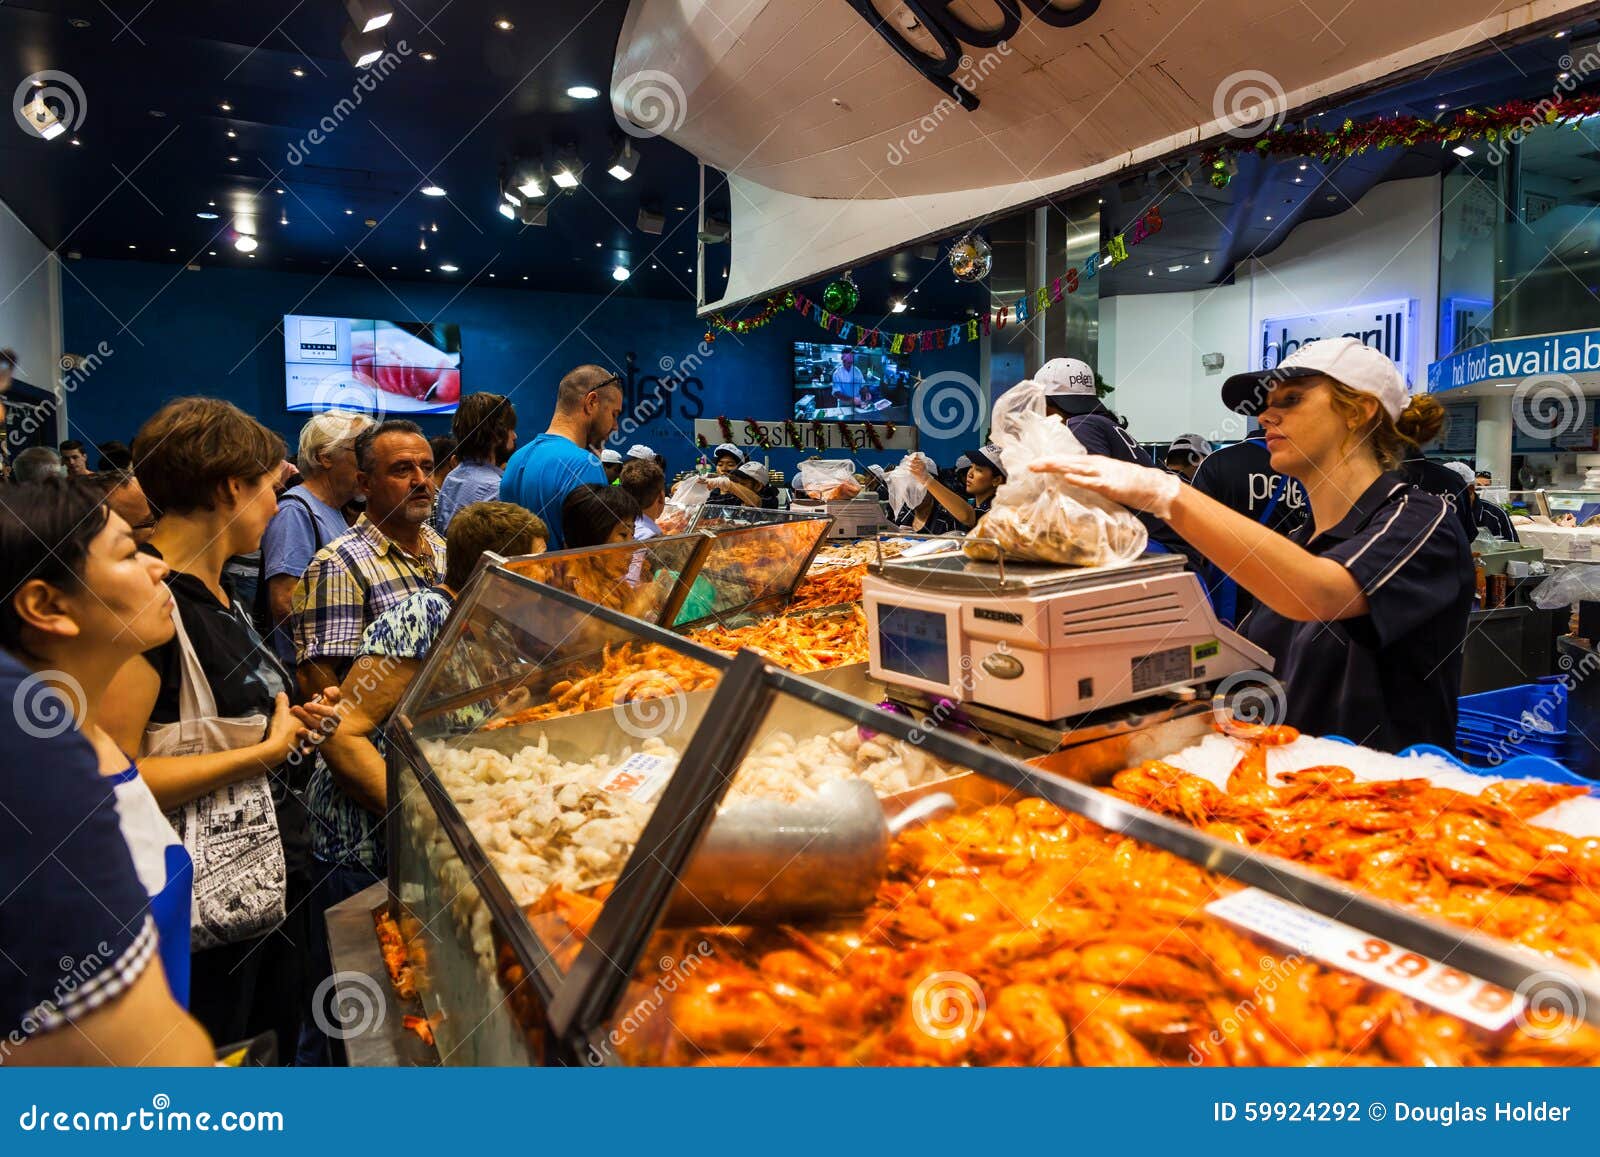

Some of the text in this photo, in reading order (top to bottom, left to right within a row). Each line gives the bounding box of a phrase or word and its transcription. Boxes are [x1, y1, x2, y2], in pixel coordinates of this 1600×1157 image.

[1342, 312, 1402, 361] rill
[1452, 355, 1465, 387] hot
[1467, 347, 1487, 383] food
